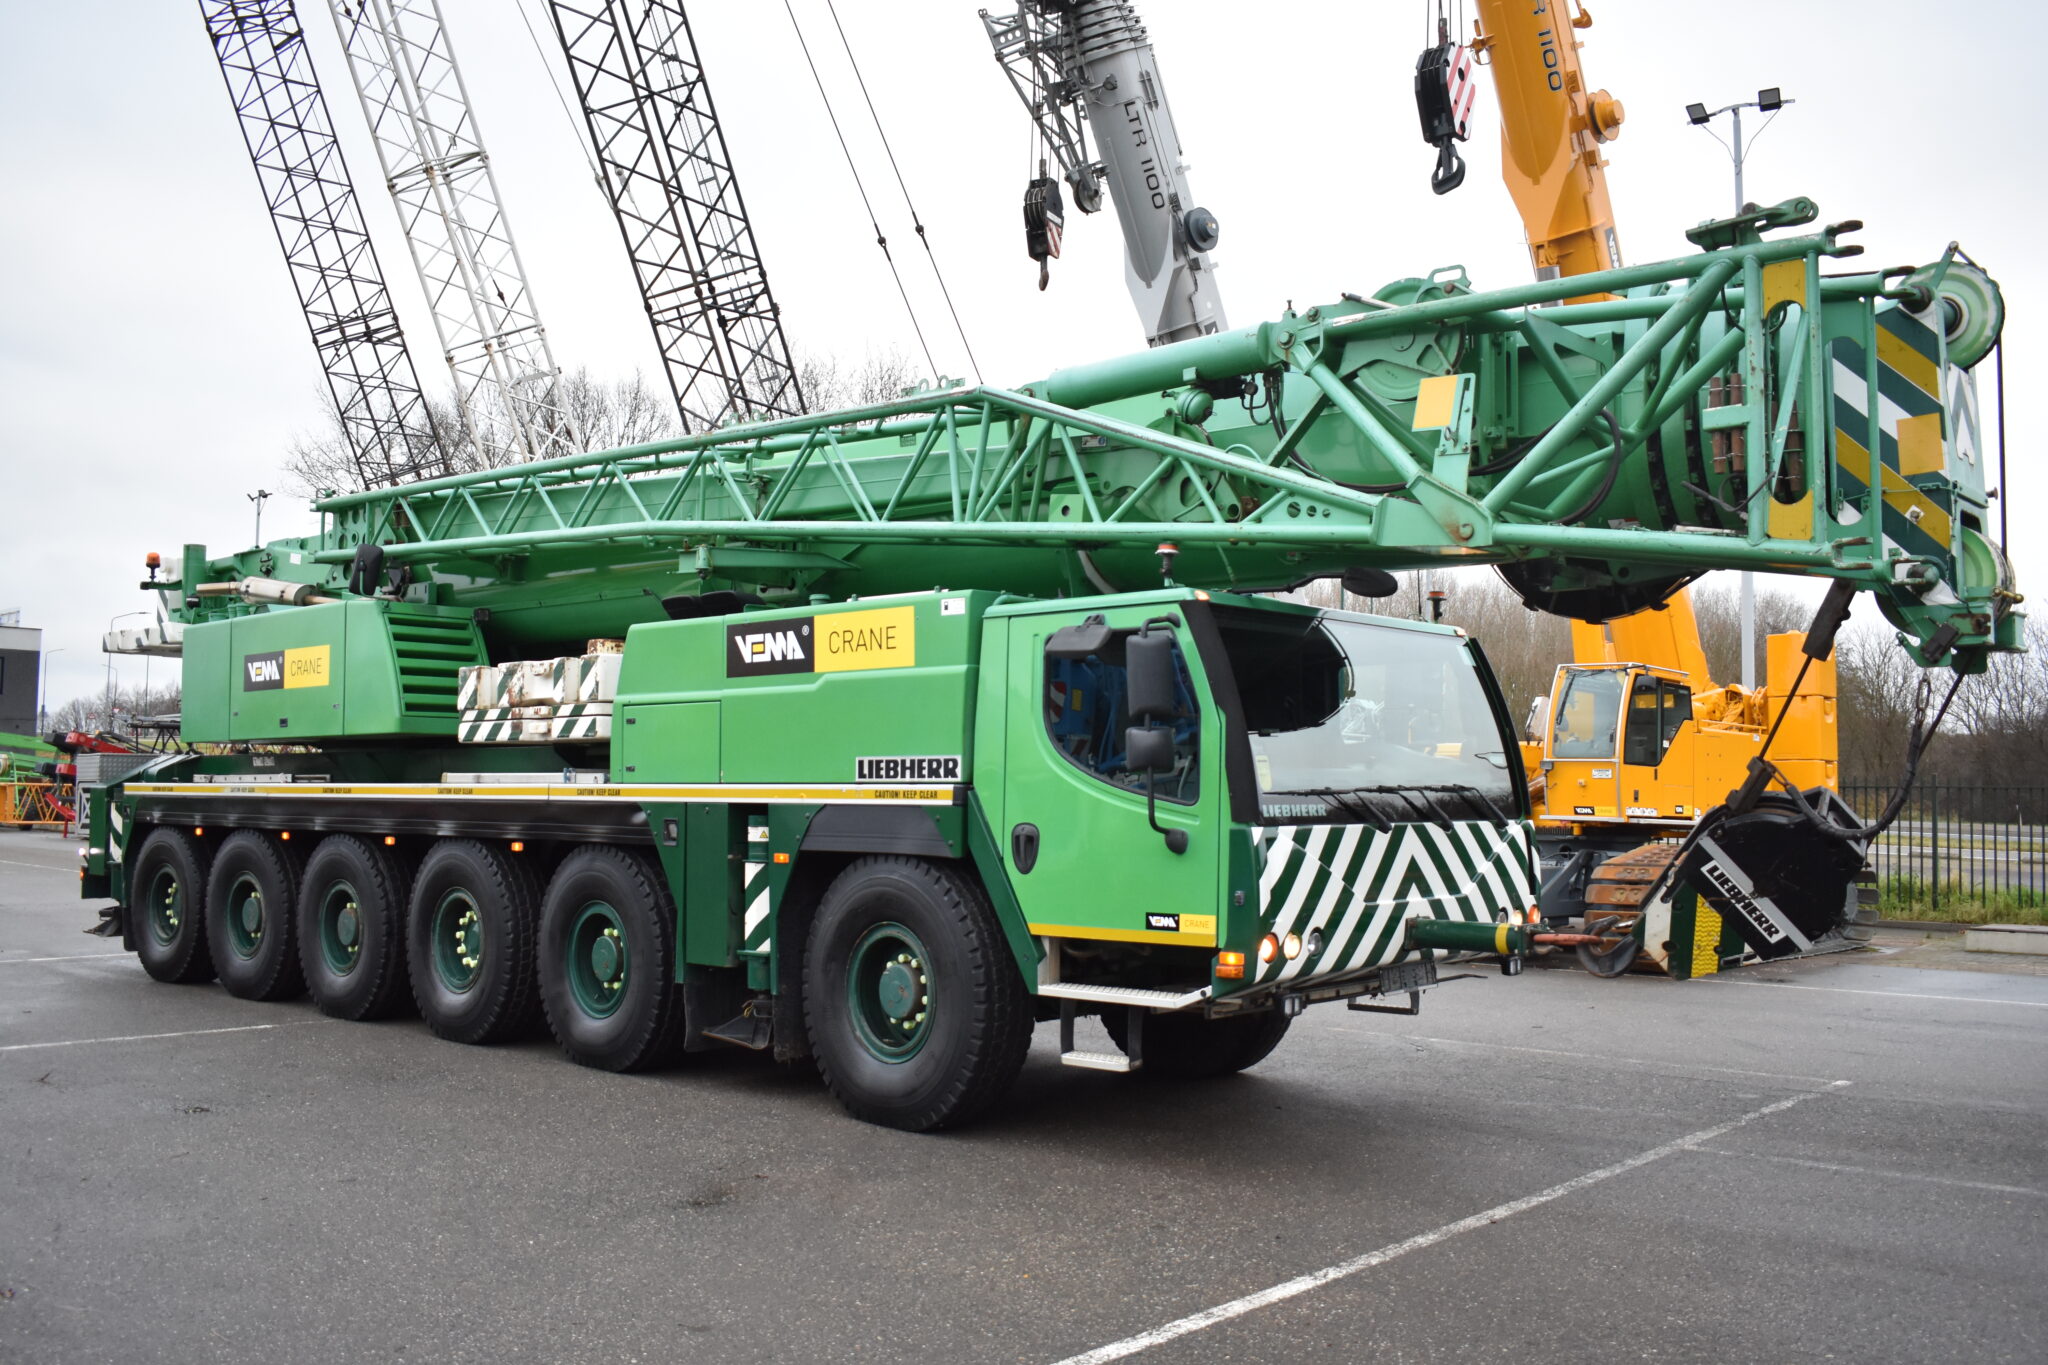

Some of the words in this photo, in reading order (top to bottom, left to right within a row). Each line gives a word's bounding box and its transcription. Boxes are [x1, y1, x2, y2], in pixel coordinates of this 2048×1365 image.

[1538, 29, 1562, 92] 1100
[1124, 101, 1147, 147] LTR
[1141, 158, 1165, 209] 1100
[828, 625, 897, 654] CRANE
[290, 657, 322, 677] CRANE
[858, 758, 959, 779] LIEBHERR
[874, 789, 900, 799] CAUTION!
[902, 789, 917, 799] KEEP
[919, 789, 938, 799] CLEAR
[1262, 804, 1327, 817] LIEBHERR
[1706, 864, 1780, 938] LIEBHERR
[1184, 919, 1210, 928] CRANE
